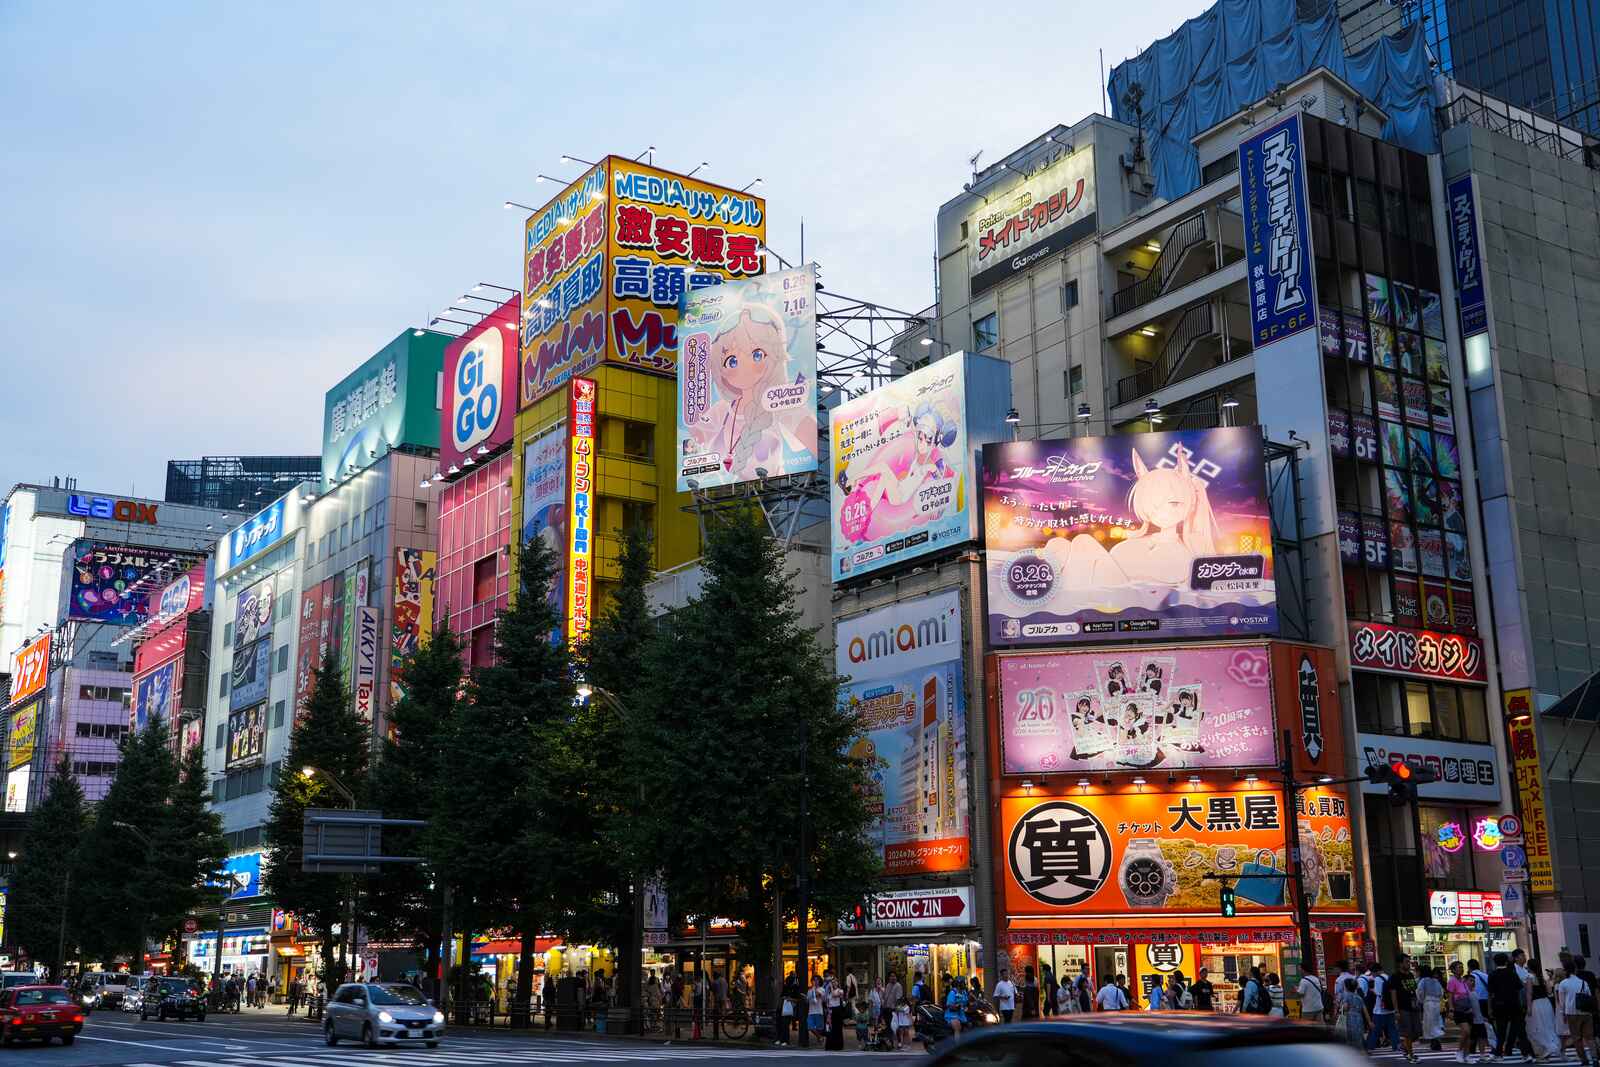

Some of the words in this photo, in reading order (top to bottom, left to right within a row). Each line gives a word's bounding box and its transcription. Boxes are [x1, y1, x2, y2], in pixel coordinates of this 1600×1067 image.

[615, 171, 762, 226] MEDIAリサイクル
[979, 178, 1085, 260] メイドカジノ
[615, 205, 759, 273] 激安販売
[1253, 265, 1268, 322] 秋葉原店
[1345, 337, 1368, 362] 7F
[1355, 436, 1377, 459] 6F
[1365, 540, 1388, 563] 5F
[360, 610, 375, 664] AKKY
[848, 614, 947, 663] amiami
[1028, 626, 1059, 634] ブルアカ
[1353, 626, 1480, 677] メイドカジノ
[1116, 822, 1163, 835] チケット
[1168, 795, 1280, 833] 大黒屋
[1503, 820, 1516, 831] 40
[1526, 764, 1541, 801] TAX
[1534, 808, 1549, 857] FREE
[1021, 817, 1103, 893] 質
[876, 900, 920, 919] COMIC
[922, 899, 942, 917] ZIN
[876, 919, 912, 928] Akihabara
[1432, 905, 1457, 917] TOKIS
